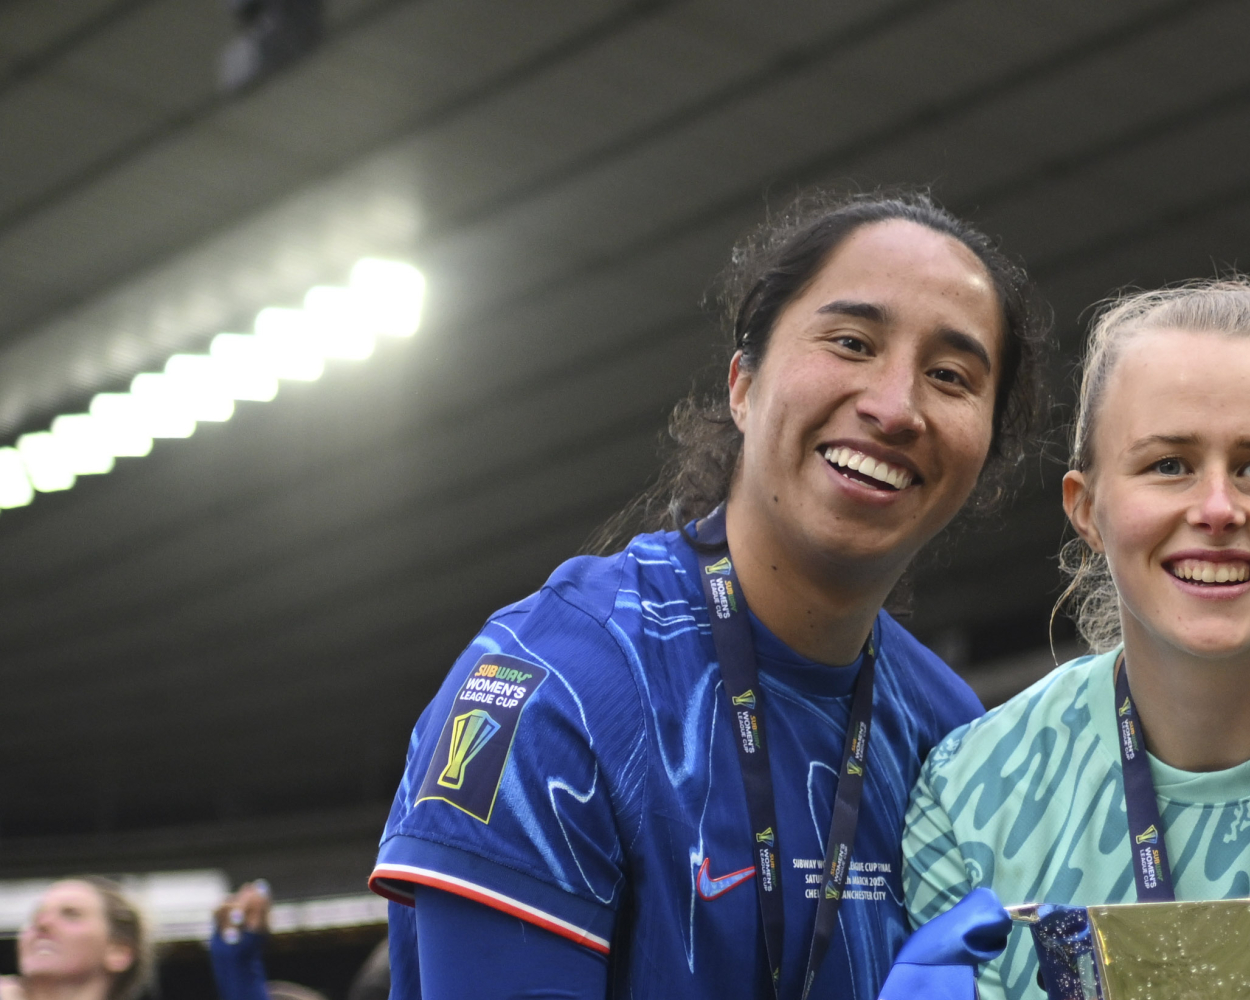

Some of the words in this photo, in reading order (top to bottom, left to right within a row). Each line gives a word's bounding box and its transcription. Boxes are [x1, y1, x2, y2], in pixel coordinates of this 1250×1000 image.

[710, 579, 719, 604] LEAGUE
[716, 577, 730, 618] WOMEN'S
[474, 664, 532, 684] SUBWAY
[466, 678, 526, 699] WOMEN'S
[460, 690, 494, 705] LEAGUE
[496, 696, 518, 709] CUP
[793, 859, 816, 868] SUBWAY
[865, 862, 877, 872] CUP
[1145, 846, 1156, 888] WOMEN'S
[869, 877, 884, 886] 2025
[842, 890, 872, 900] ANCHESTER
[873, 891, 886, 900] CITY
